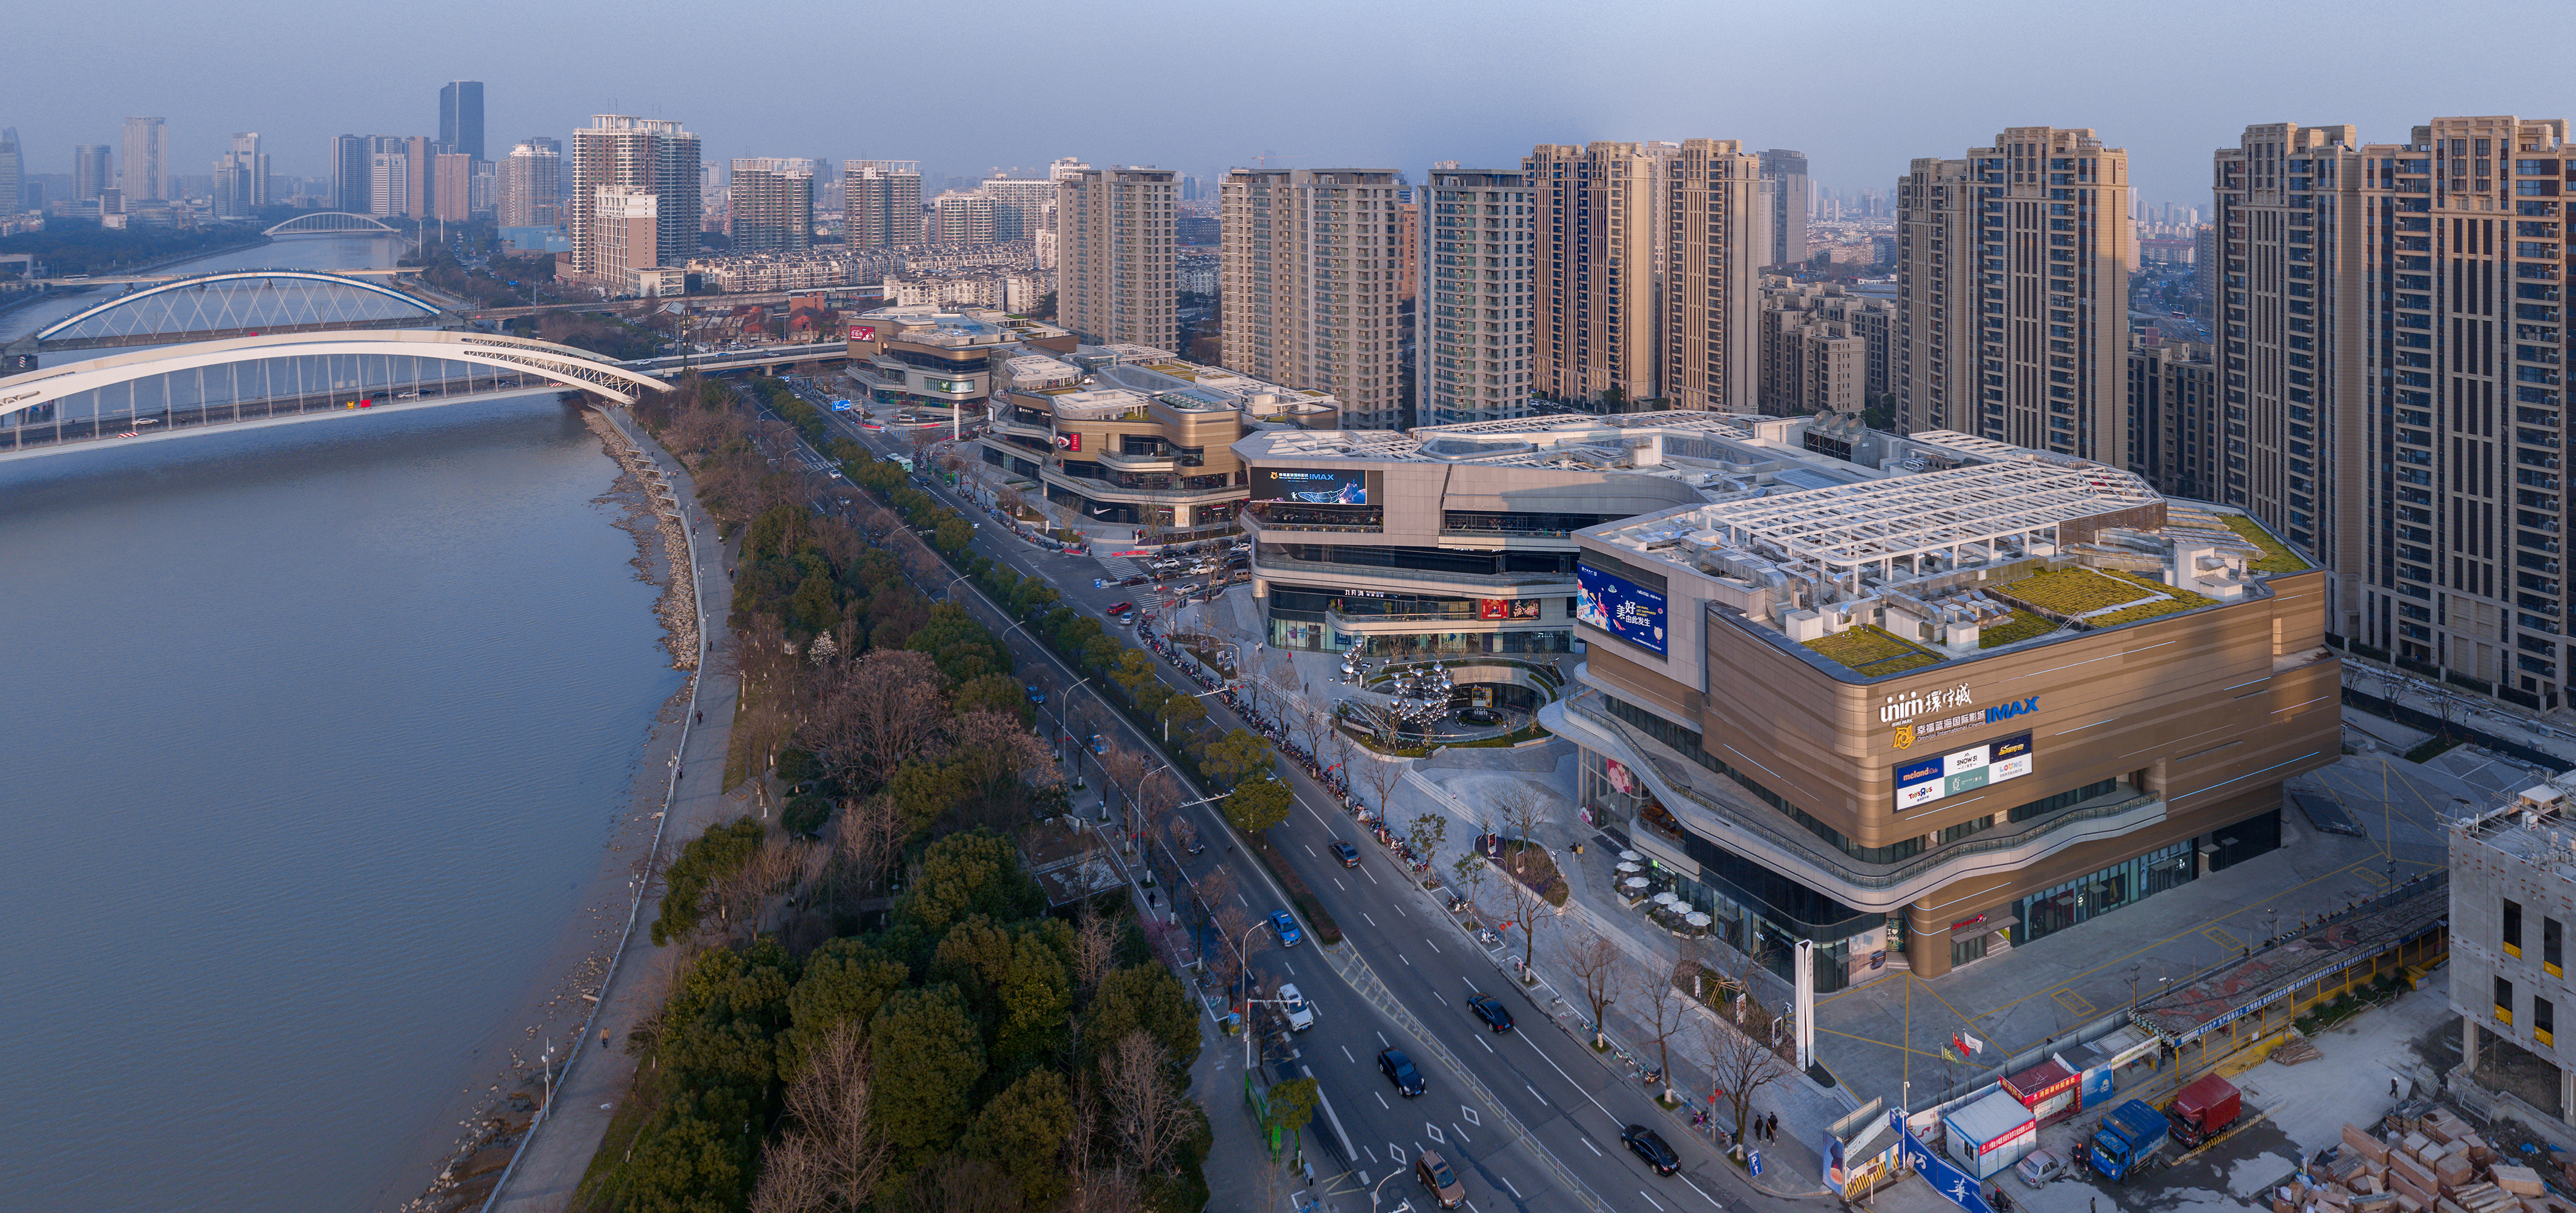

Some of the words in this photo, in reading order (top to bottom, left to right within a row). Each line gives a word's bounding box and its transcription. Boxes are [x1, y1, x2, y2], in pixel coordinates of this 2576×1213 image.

[1626, 615, 1651, 627] 由此发生
[1916, 710, 1985, 735] 幸福蓝海国际影城
[1986, 696, 2040, 724] IMAX
[1917, 733, 1936, 742] Omnijoi
[1937, 723, 1967, 737] International
[1968, 721, 1986, 729] Cinema
[1957, 756, 1973, 766] SNOW
[1903, 767, 1929, 781] meland
[1752, 1156, 1757, 1165] P
